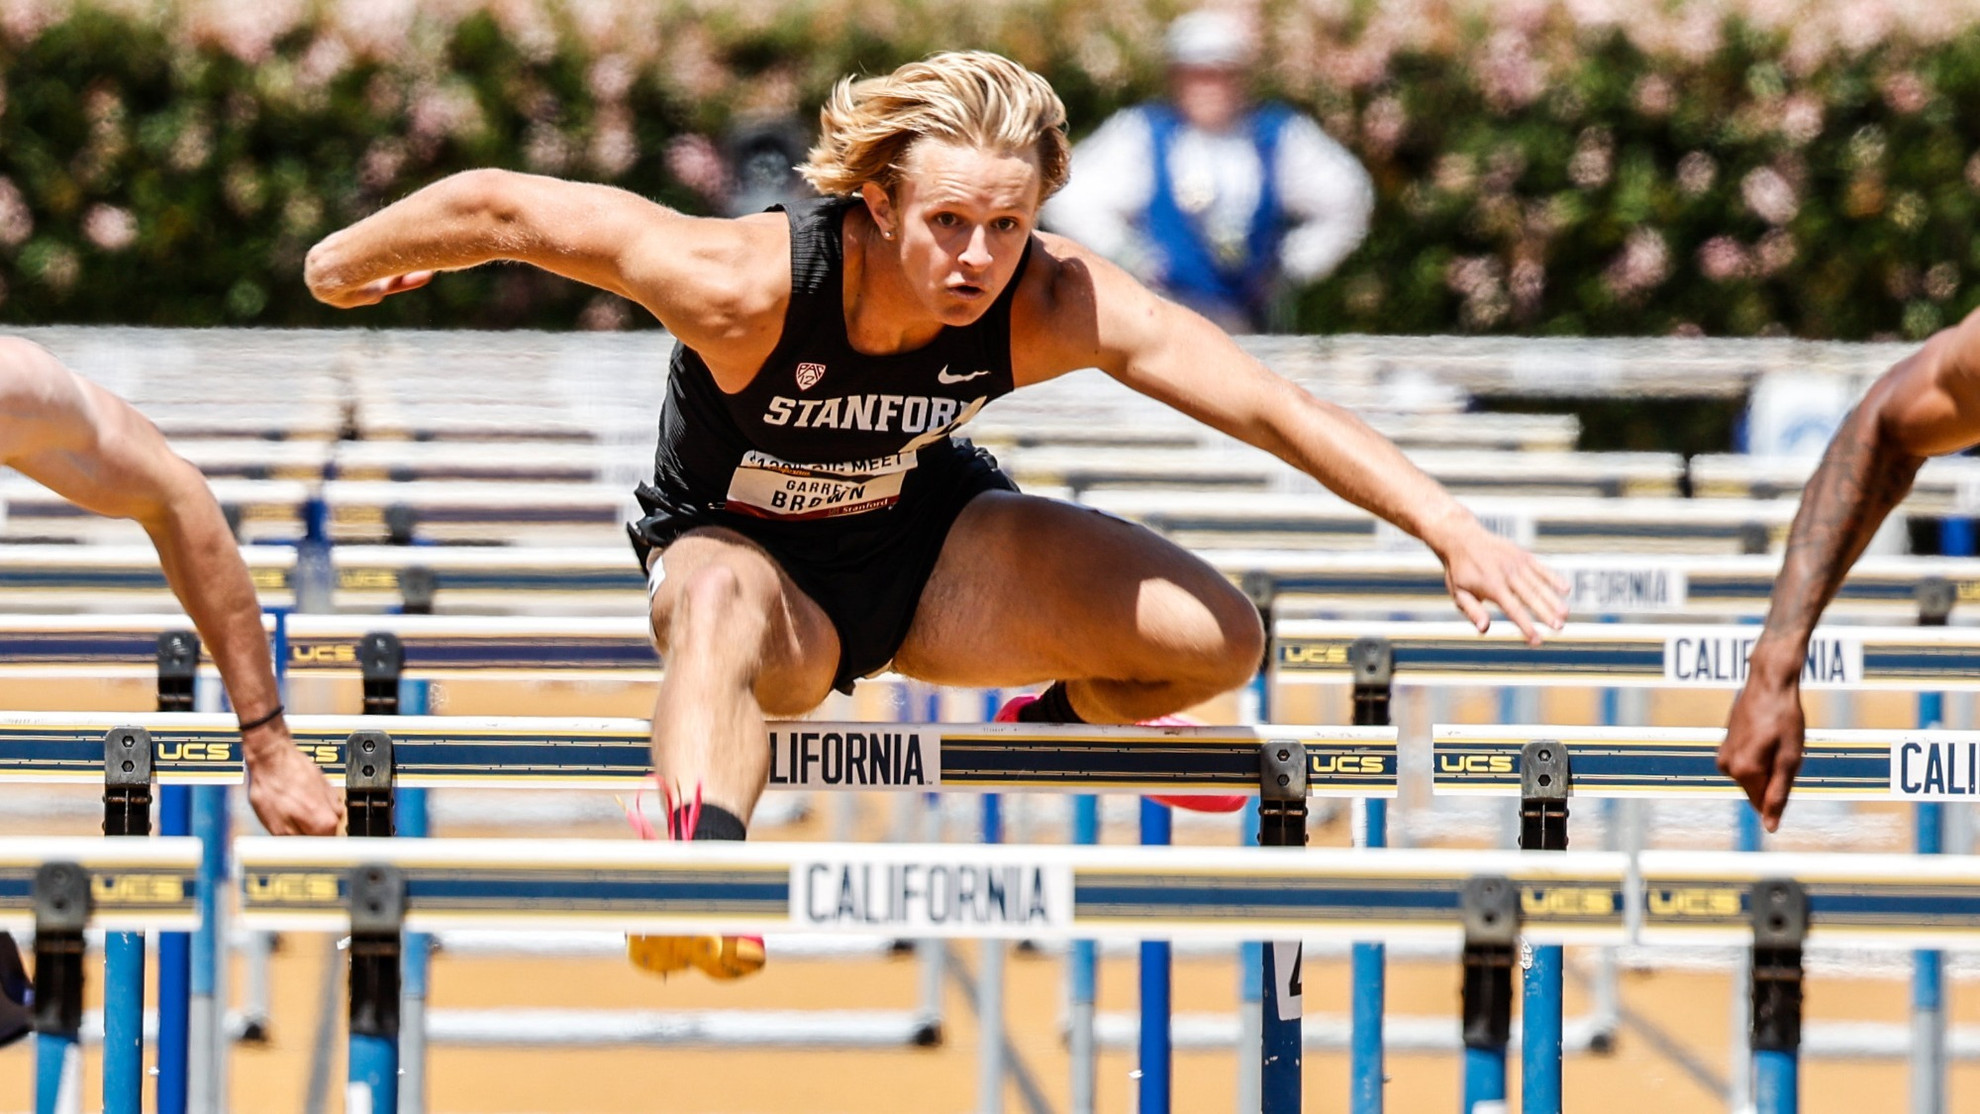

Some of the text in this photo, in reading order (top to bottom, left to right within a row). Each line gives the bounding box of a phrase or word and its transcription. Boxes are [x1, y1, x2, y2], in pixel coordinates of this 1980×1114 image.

[763, 394, 972, 433] STANFOR
[771, 485, 866, 512] BROWN
[842, 498, 888, 513] Stanford
[293, 645, 356, 662] UCS
[1285, 644, 1347, 663] UCS
[1675, 637, 1845, 683] CALIFNIA
[158, 743, 232, 761] UCS
[769, 732, 925, 785] LIFORNIA
[1312, 755, 1385, 773] UCS
[1441, 755, 1513, 773] UCS
[1901, 742, 1980, 794] CALI
[92, 874, 184, 901] UCS
[247, 873, 339, 901] UCS
[807, 862, 1049, 923] CALIFORNIA
[1520, 887, 1614, 915] UCS
[1649, 888, 1741, 915] UCS
